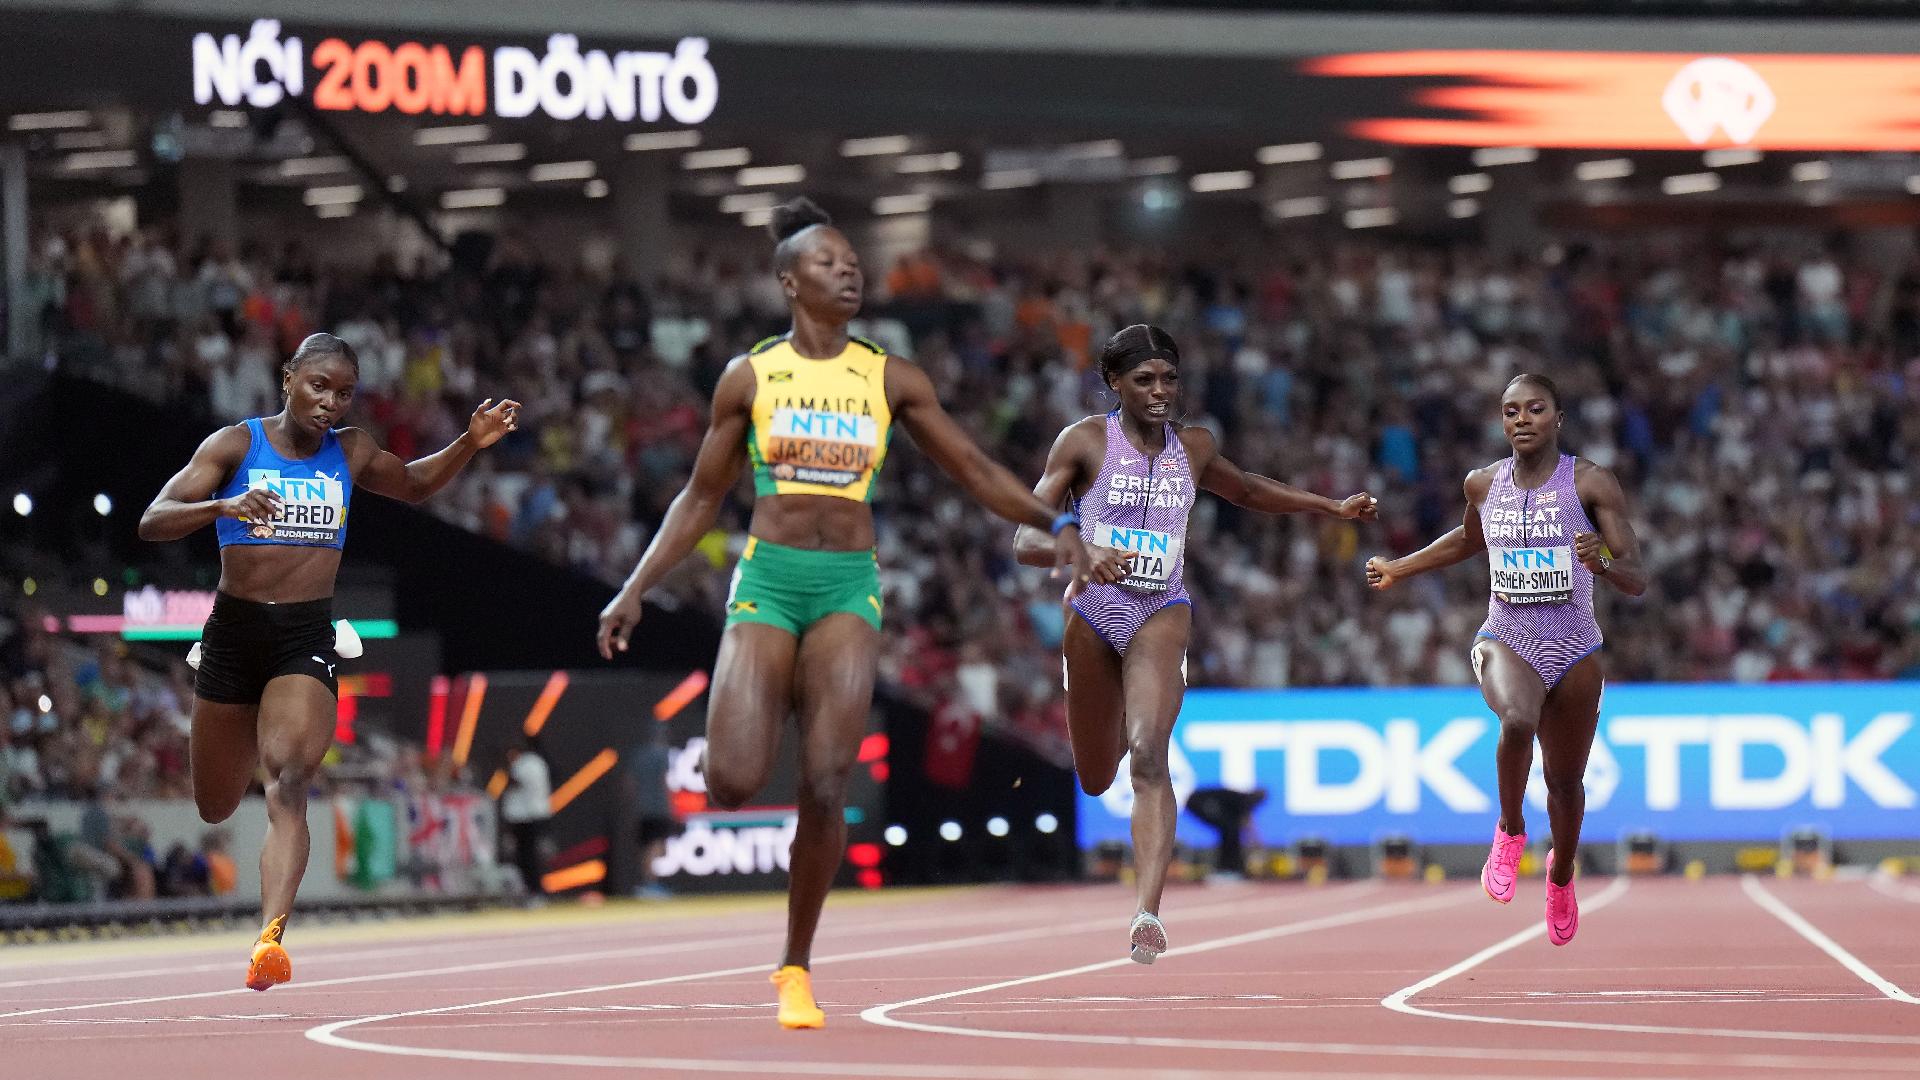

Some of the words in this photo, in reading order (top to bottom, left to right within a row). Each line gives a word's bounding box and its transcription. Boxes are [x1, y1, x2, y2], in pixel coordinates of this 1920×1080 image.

[312, 38, 486, 116] 200M
[791, 413, 857, 437] NTN
[773, 440, 870, 466] JACKSON
[266, 480, 326, 501] NTN
[1111, 474, 1184, 492] GREAT
[1107, 490, 1186, 508] BRITAIN
[271, 504, 334, 525] LFRED
[1490, 507, 1560, 524] GREAT
[1110, 527, 1169, 555] NTN
[1488, 523, 1563, 538] BRITAIN
[1502, 548, 1555, 569] NTN
[1494, 570, 1569, 589] ASHER-SMITH
[1184, 717, 1491, 815] TDK
[1608, 712, 1917, 811] TDK
